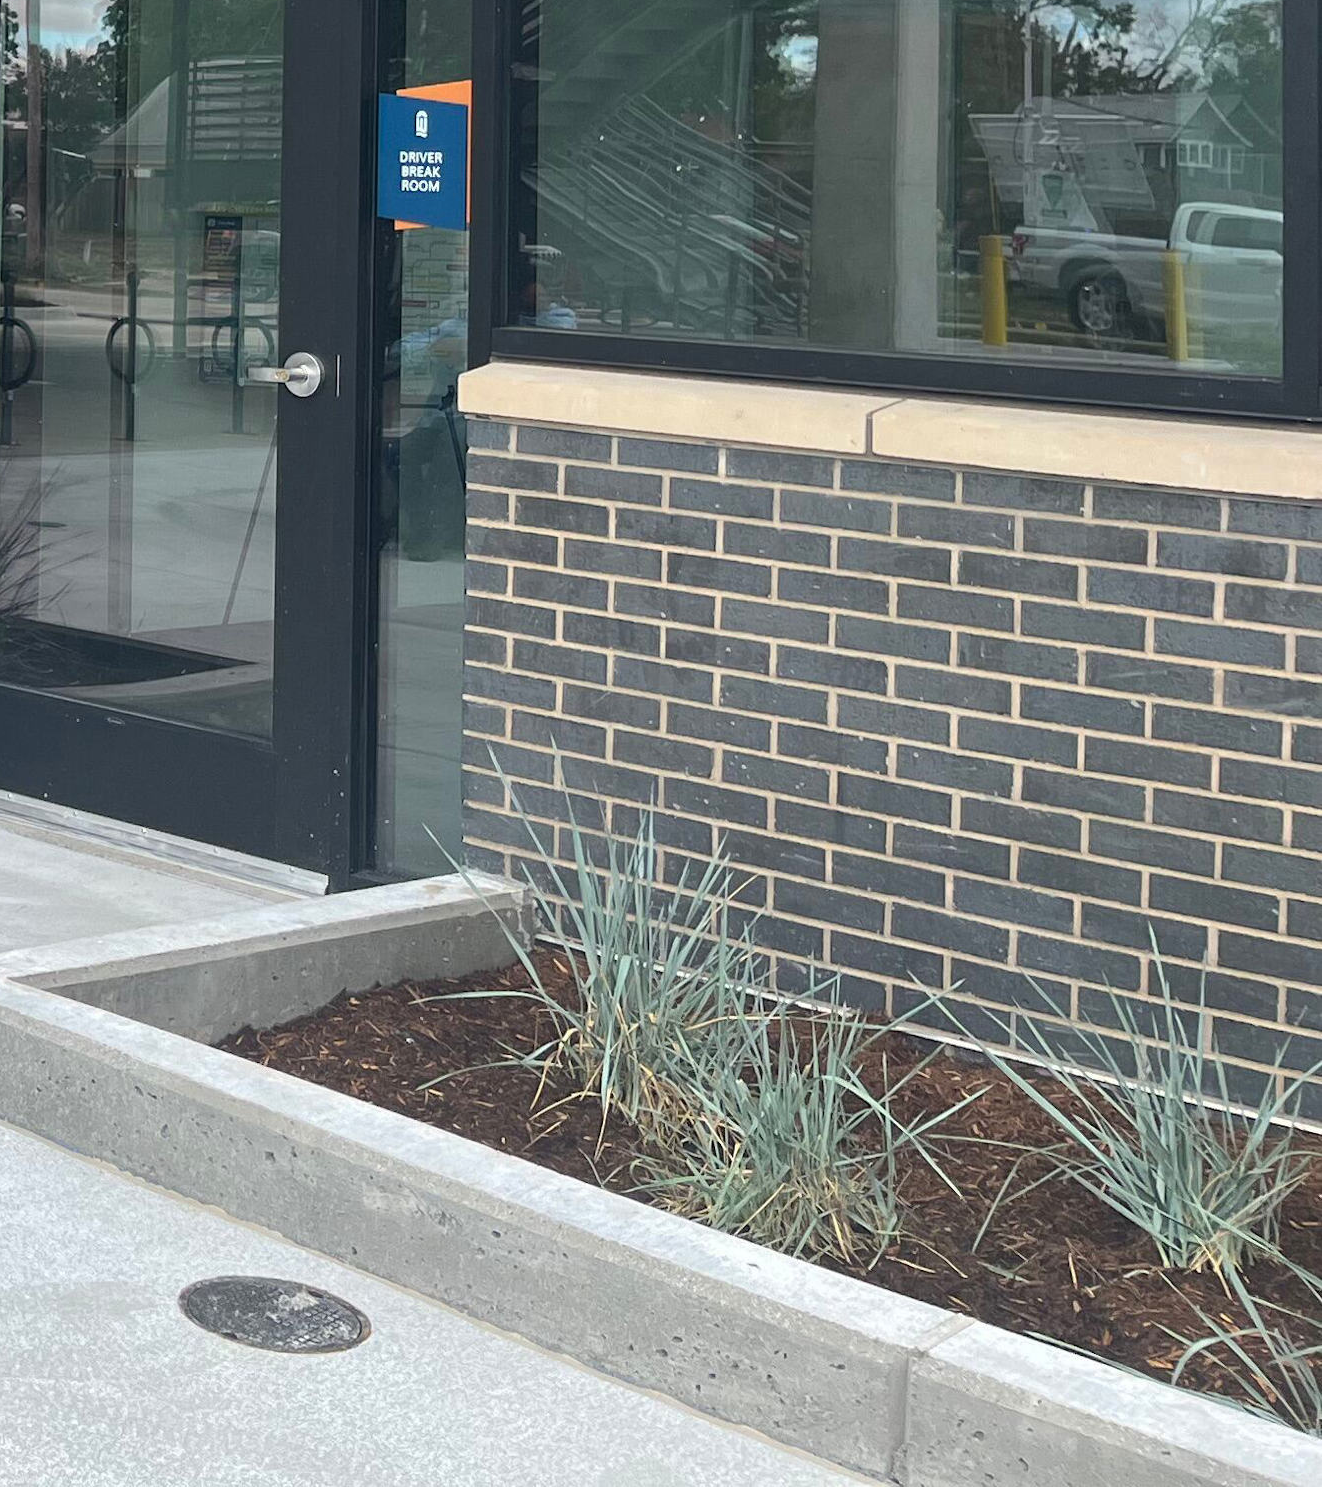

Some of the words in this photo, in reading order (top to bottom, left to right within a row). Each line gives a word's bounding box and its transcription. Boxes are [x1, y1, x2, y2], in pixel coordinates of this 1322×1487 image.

[399, 151, 443, 164] DRIVER
[401, 165, 442, 179] BREAK
[401, 179, 441, 193] ROOM
